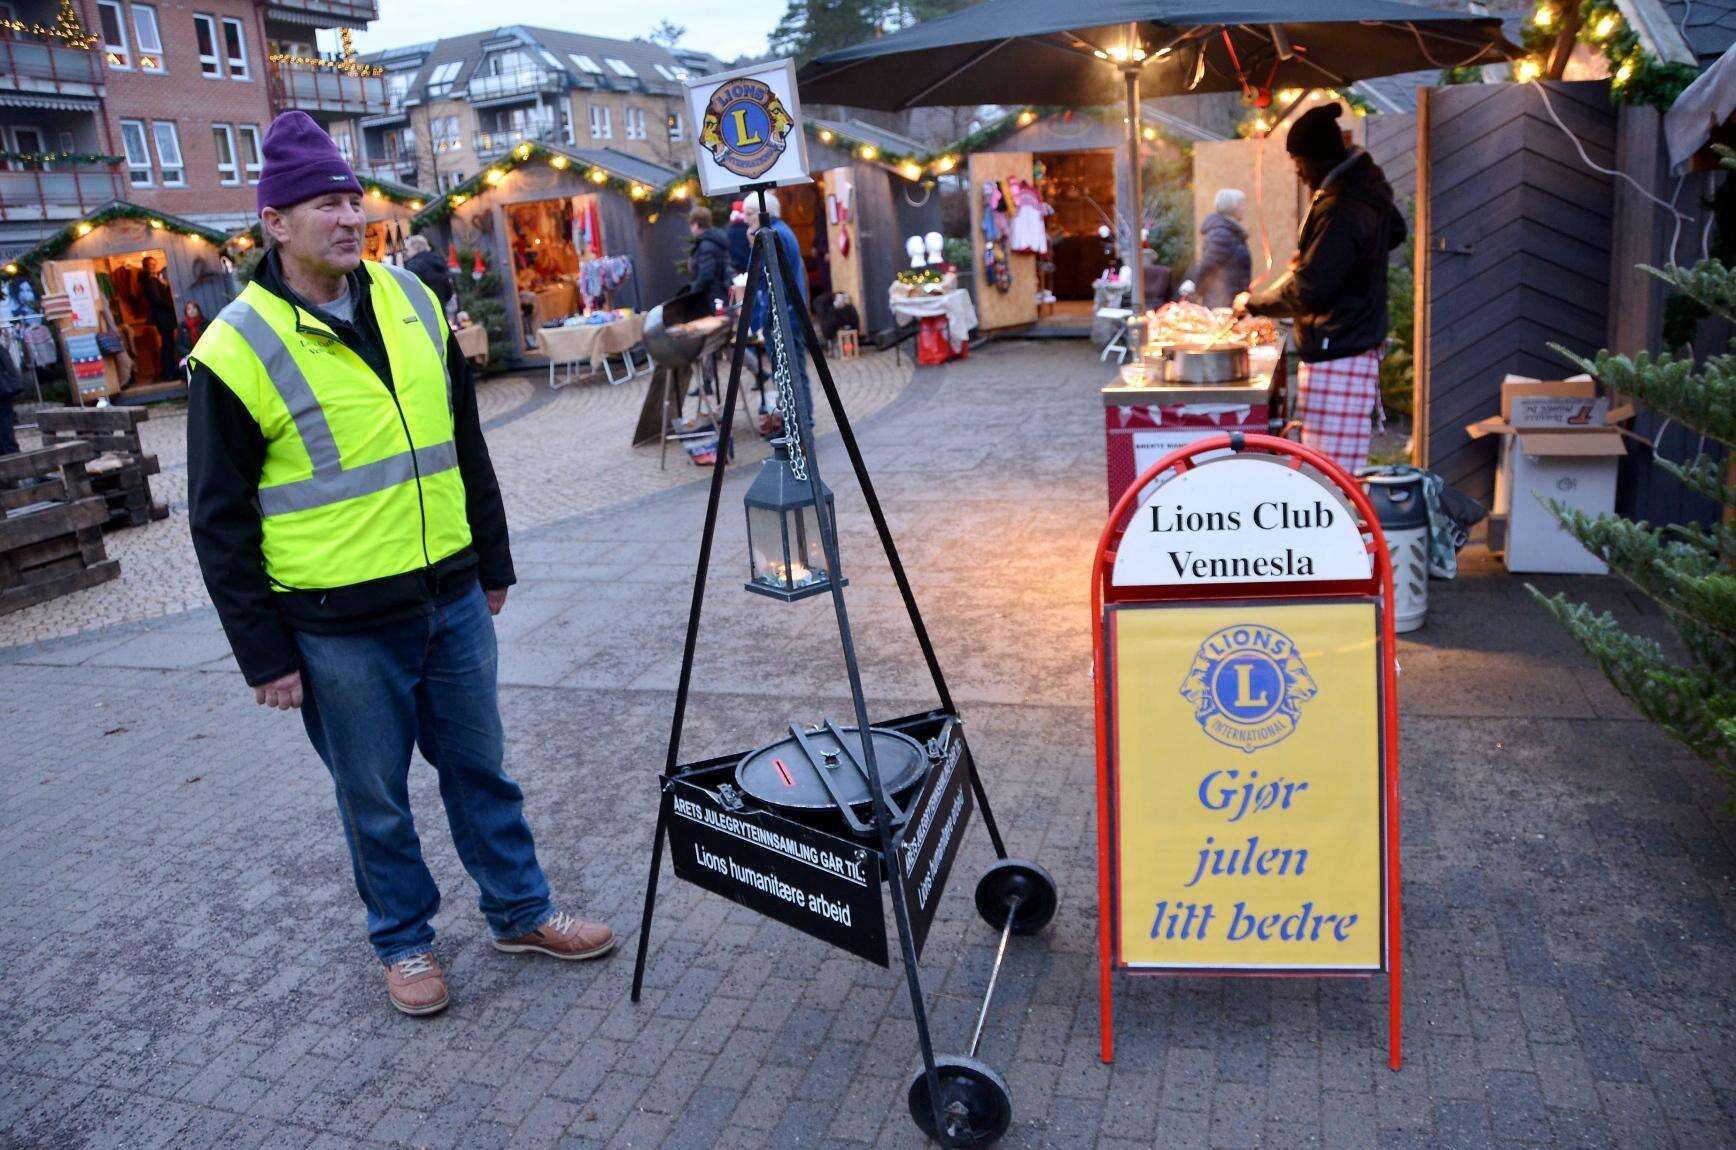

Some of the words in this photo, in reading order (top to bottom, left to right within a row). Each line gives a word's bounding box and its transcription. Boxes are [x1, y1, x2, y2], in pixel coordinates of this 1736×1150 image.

[716, 84, 765, 105] LIONS
[731, 109, 762, 147] L
[1150, 504, 1241, 533] Lions
[1253, 501, 1335, 530] Club
[1167, 549, 1316, 579] Vennesla
[1209, 629, 1286, 656] LIONS
[1233, 664, 1269, 707] L
[1213, 719, 1288, 741] INTERNATIONAL
[1198, 769, 1309, 822] Gjør
[704, 808, 819, 865] JULEGRYTEINNSAMLING
[844, 860, 867, 883] TIL:
[1183, 836, 1308, 887] julen
[694, 842, 728, 875] Lions
[729, 856, 806, 907] humanitære
[807, 893, 852, 927] arbeid
[1150, 901, 1216, 940] litt
[1227, 902, 1359, 942] bedre
